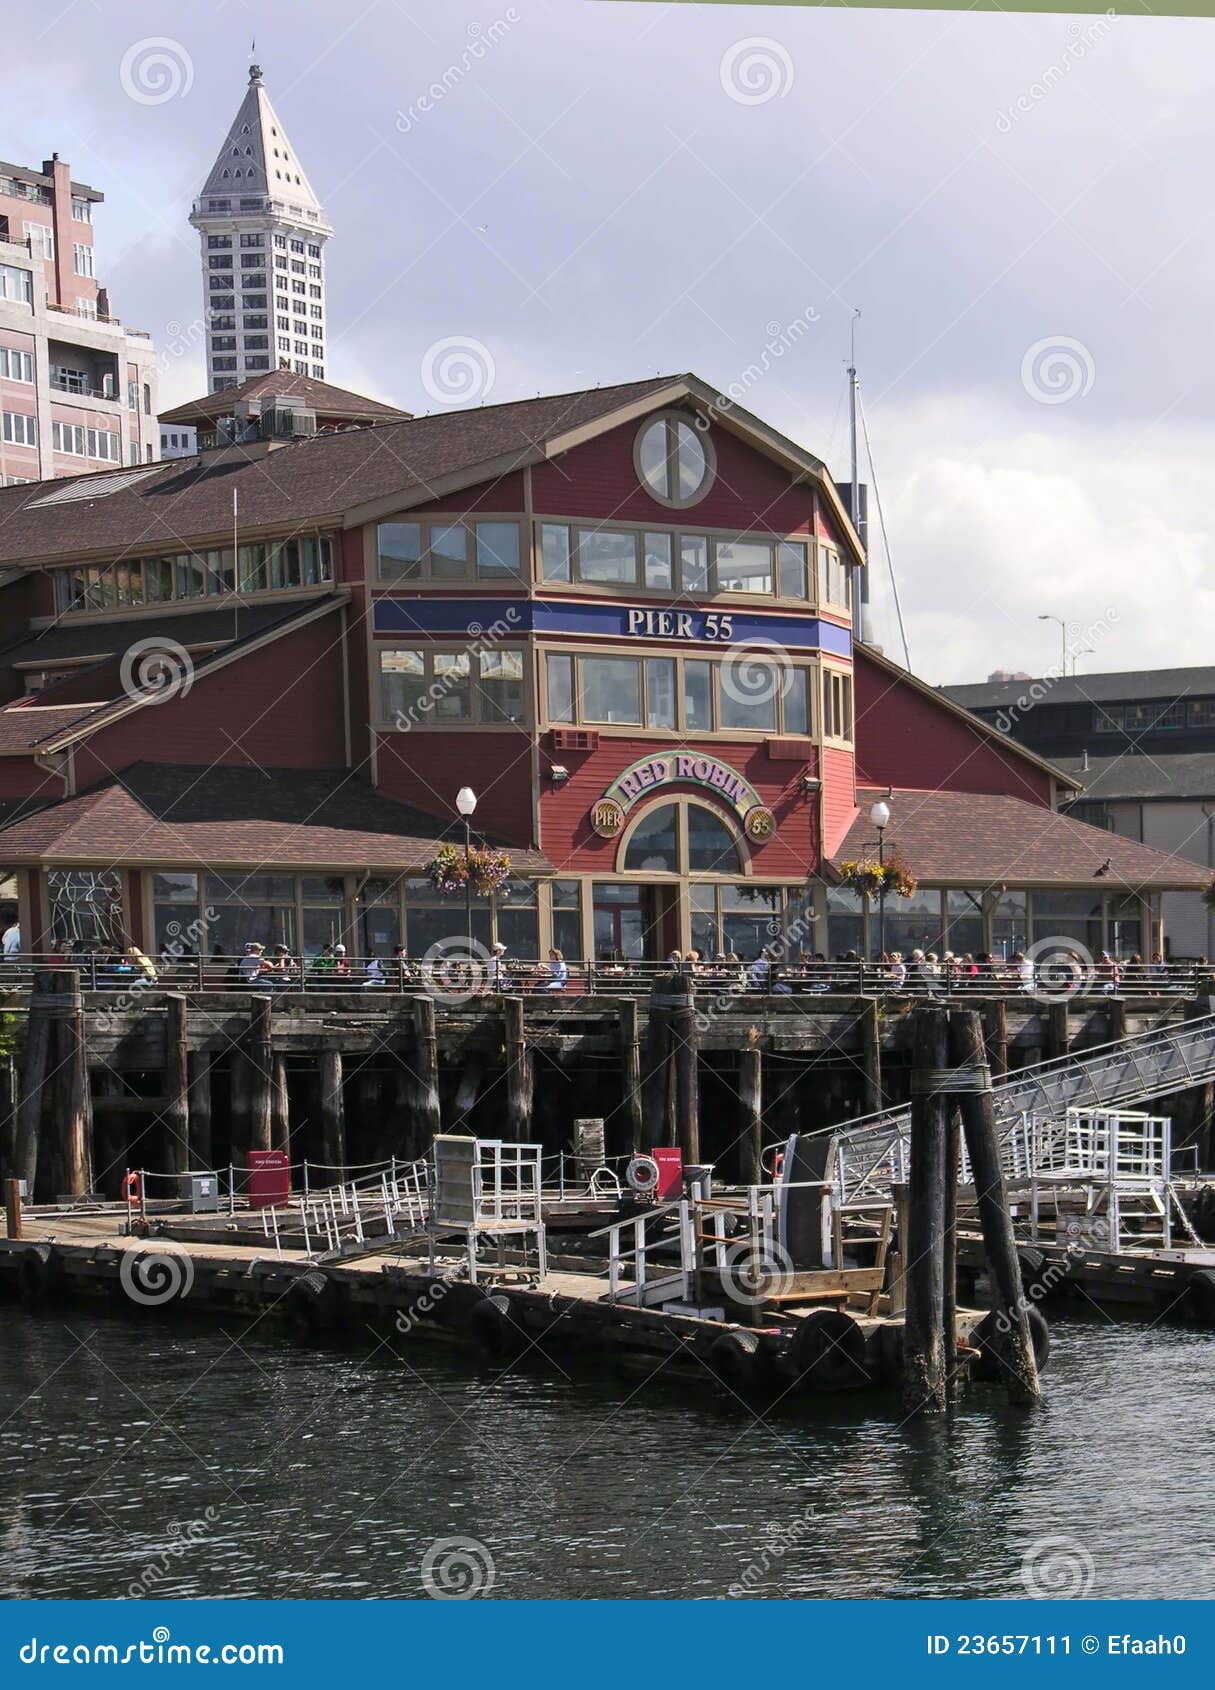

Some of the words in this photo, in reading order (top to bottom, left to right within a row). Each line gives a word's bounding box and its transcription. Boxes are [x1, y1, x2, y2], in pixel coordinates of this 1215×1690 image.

[627, 609, 694, 638] PIER
[704, 614, 733, 640] 55
[618, 759, 670, 799] RED
[675, 755, 750, 801] ROBIN
[595, 811, 621, 827] PIER
[752, 818, 769, 834] 55
